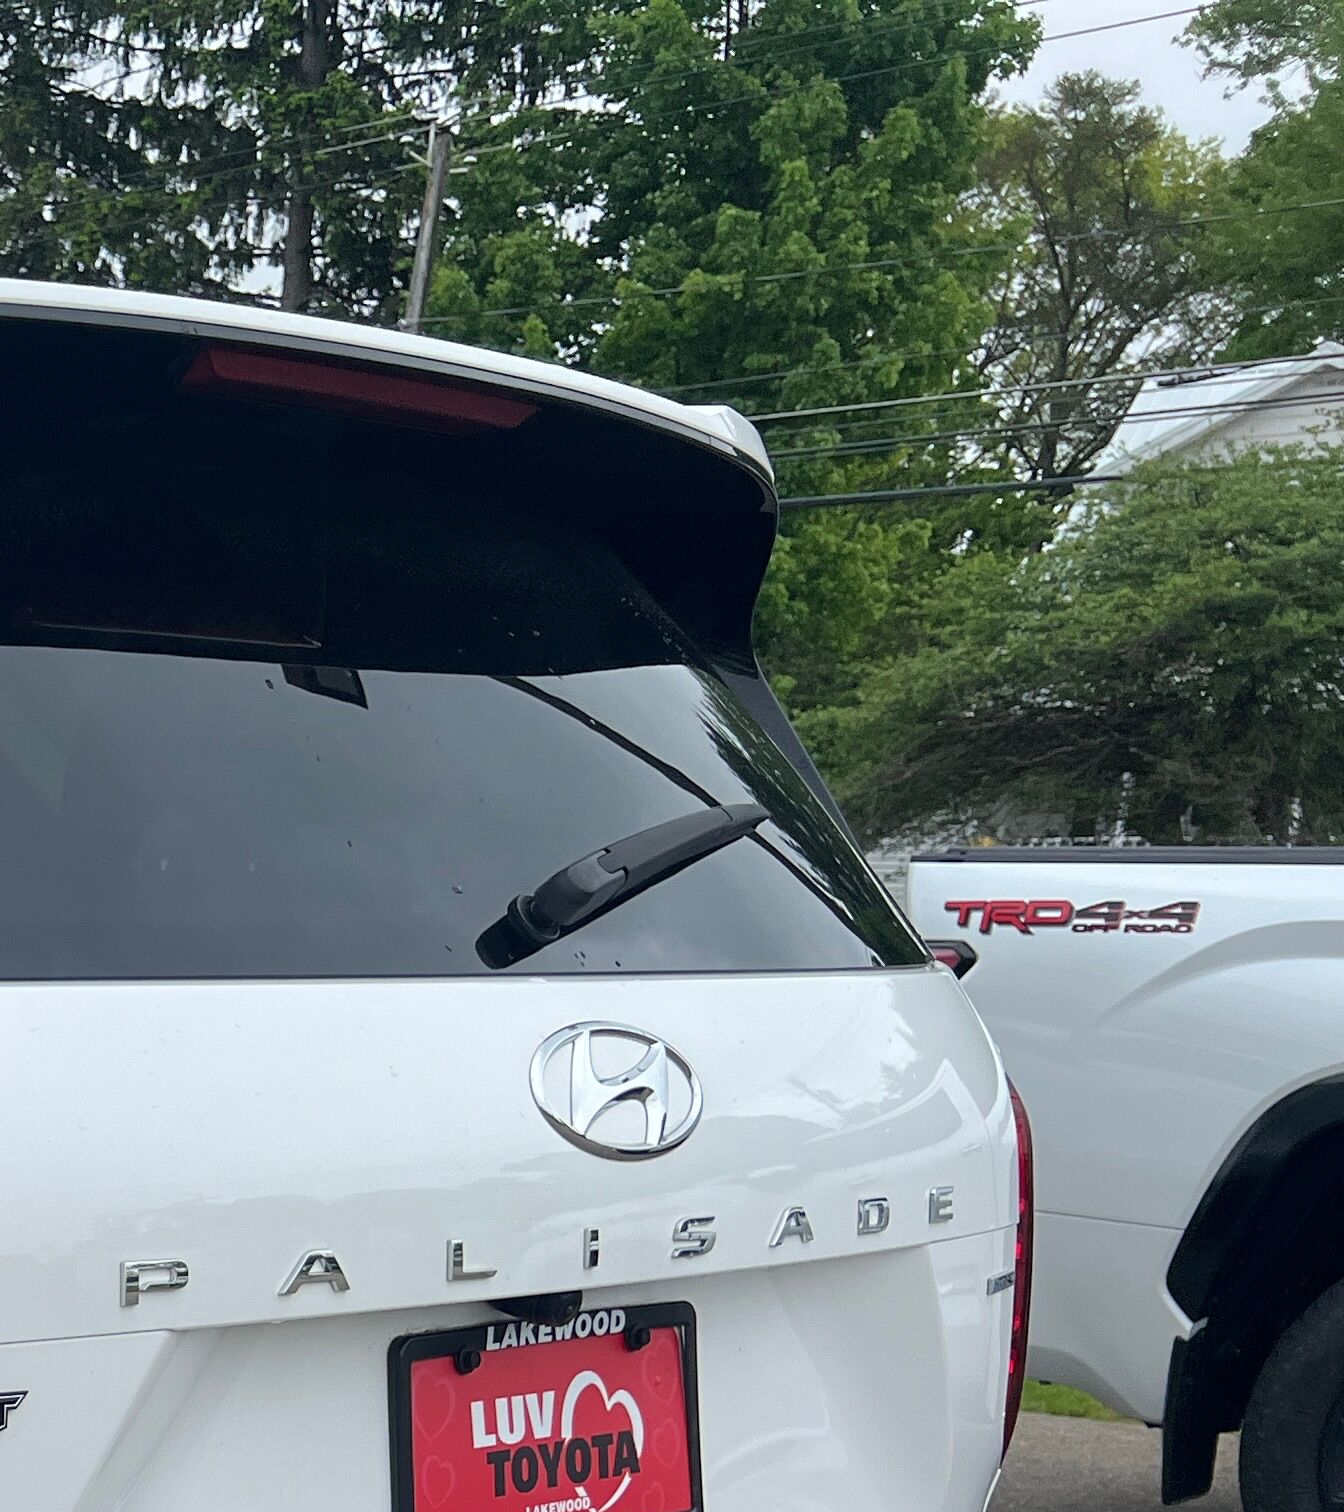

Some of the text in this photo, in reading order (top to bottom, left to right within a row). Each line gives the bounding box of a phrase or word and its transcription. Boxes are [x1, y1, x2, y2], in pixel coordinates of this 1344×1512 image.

[945, 900, 1074, 935] TRD
[120, 1185, 956, 1307] PALISADE
[486, 1309, 626, 1351] LAKEWOOD
[469, 1390, 555, 1449] LUV
[487, 1430, 640, 1497] TOYOTA
